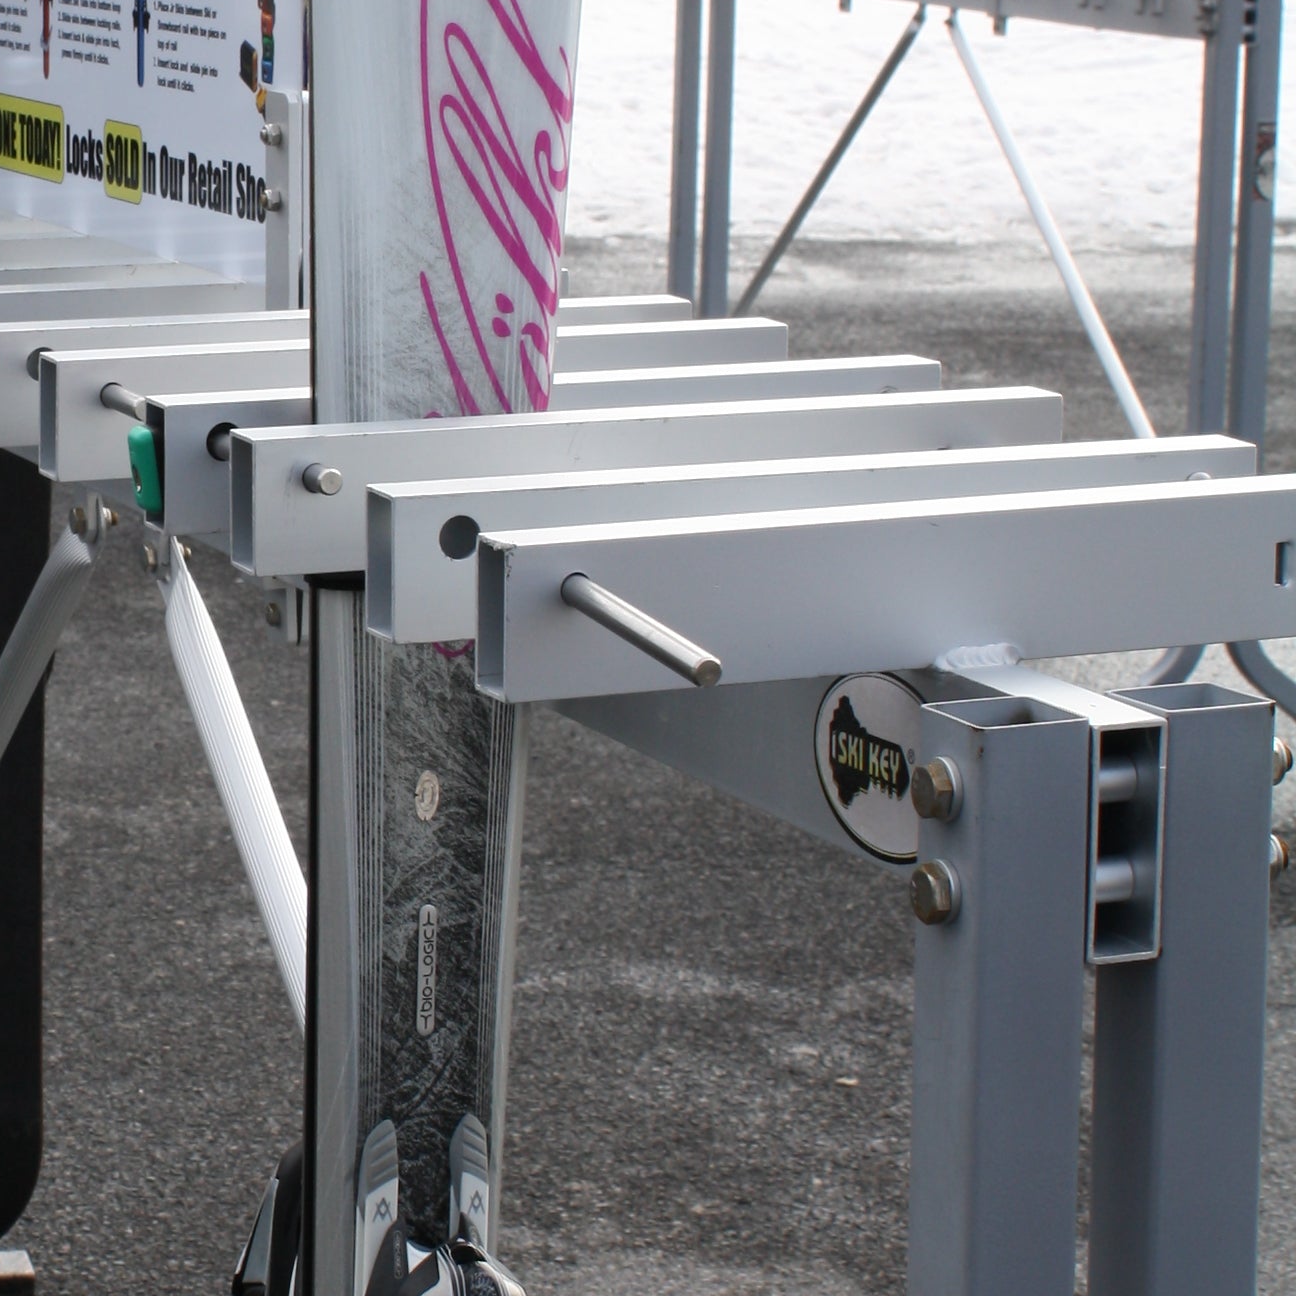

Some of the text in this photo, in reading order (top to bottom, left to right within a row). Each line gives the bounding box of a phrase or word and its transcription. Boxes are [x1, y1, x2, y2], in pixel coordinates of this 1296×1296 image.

[19, 114, 62, 170] TODAY!
[66, 124, 266, 224] Locks SOLD In Our Retail Sho
[869, 741, 900, 785] KEY
